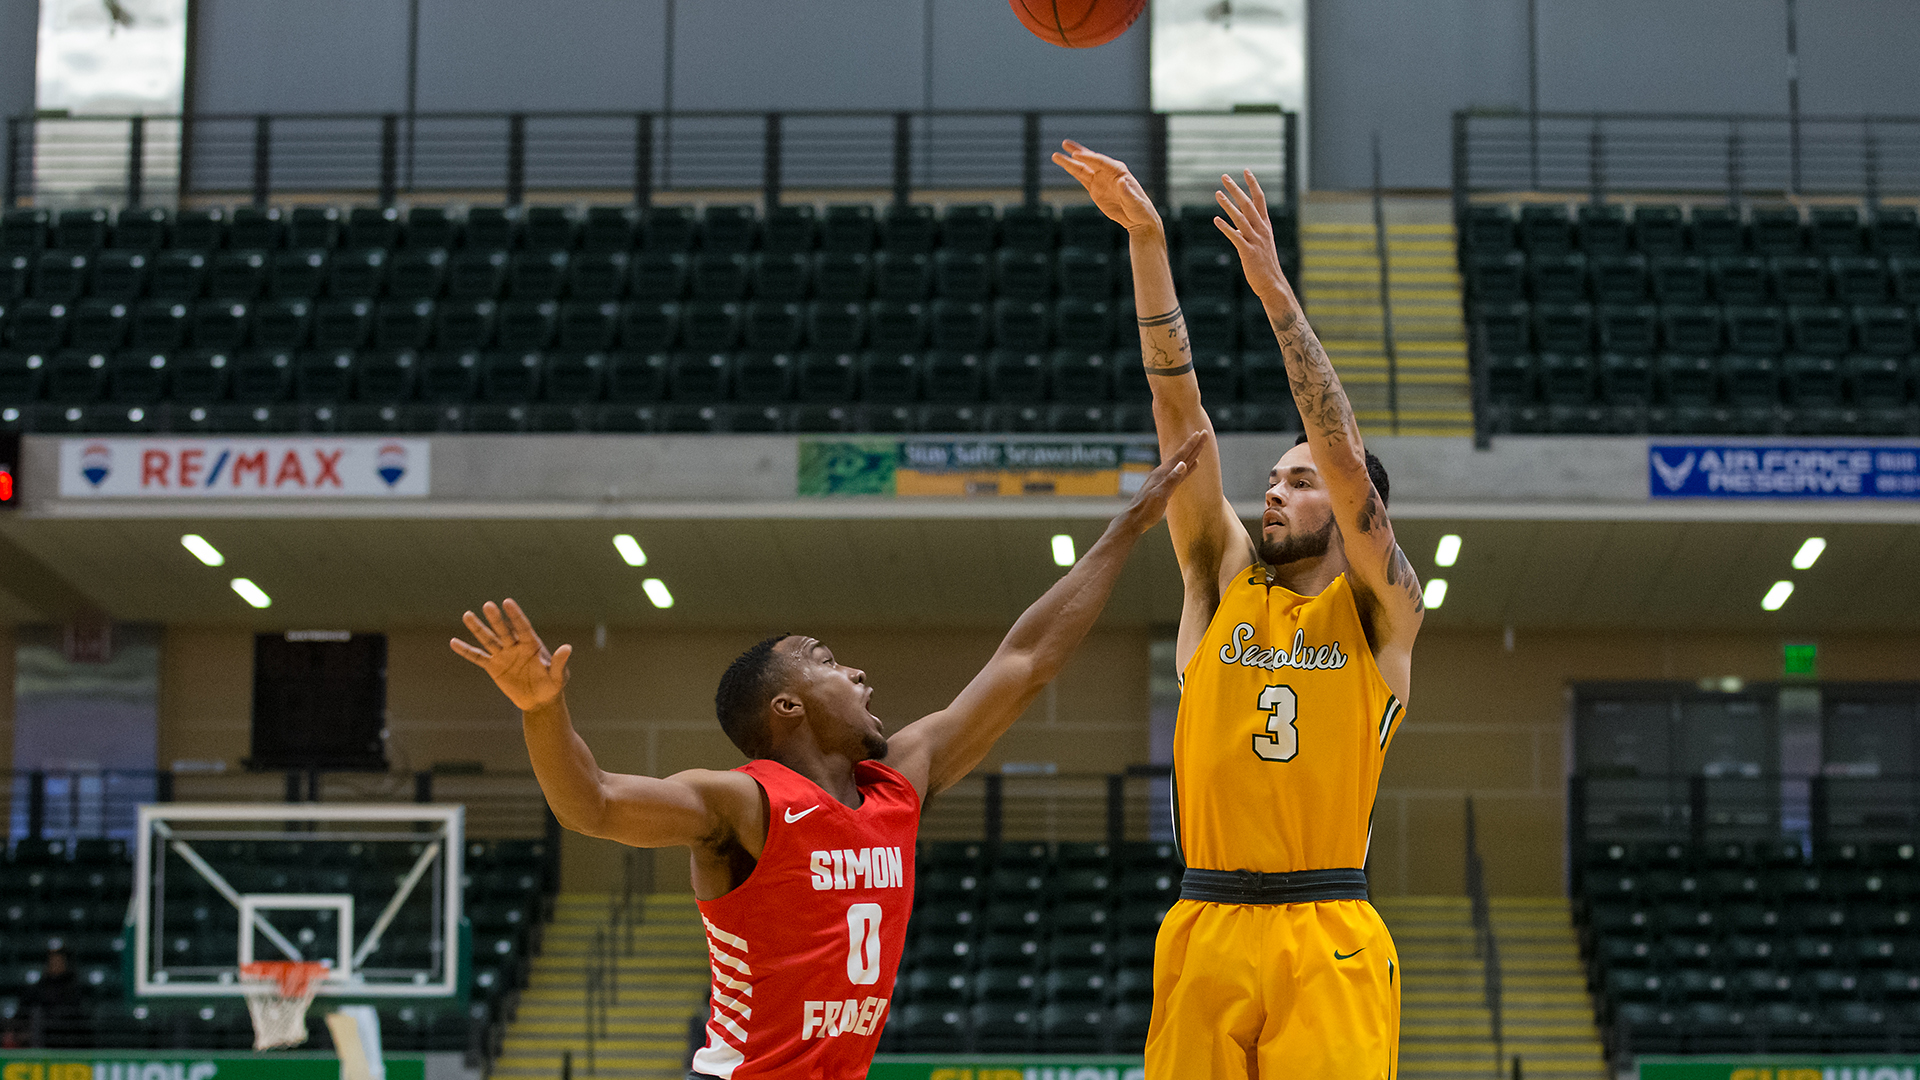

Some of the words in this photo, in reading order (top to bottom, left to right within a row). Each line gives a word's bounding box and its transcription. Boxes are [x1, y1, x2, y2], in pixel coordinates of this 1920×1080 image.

[140, 449, 344, 487] RE/MAX
[1700, 451, 1758, 472] AIR
[1762, 451, 1872, 473] FORCE
[1708, 473, 1862, 492] RESERVE
[1219, 622, 1348, 672] Seaolves
[1252, 684, 1299, 763] 3
[810, 847, 903, 890] SIMON
[846, 903, 882, 985] 0
[802, 996, 888, 1040] FRAER
